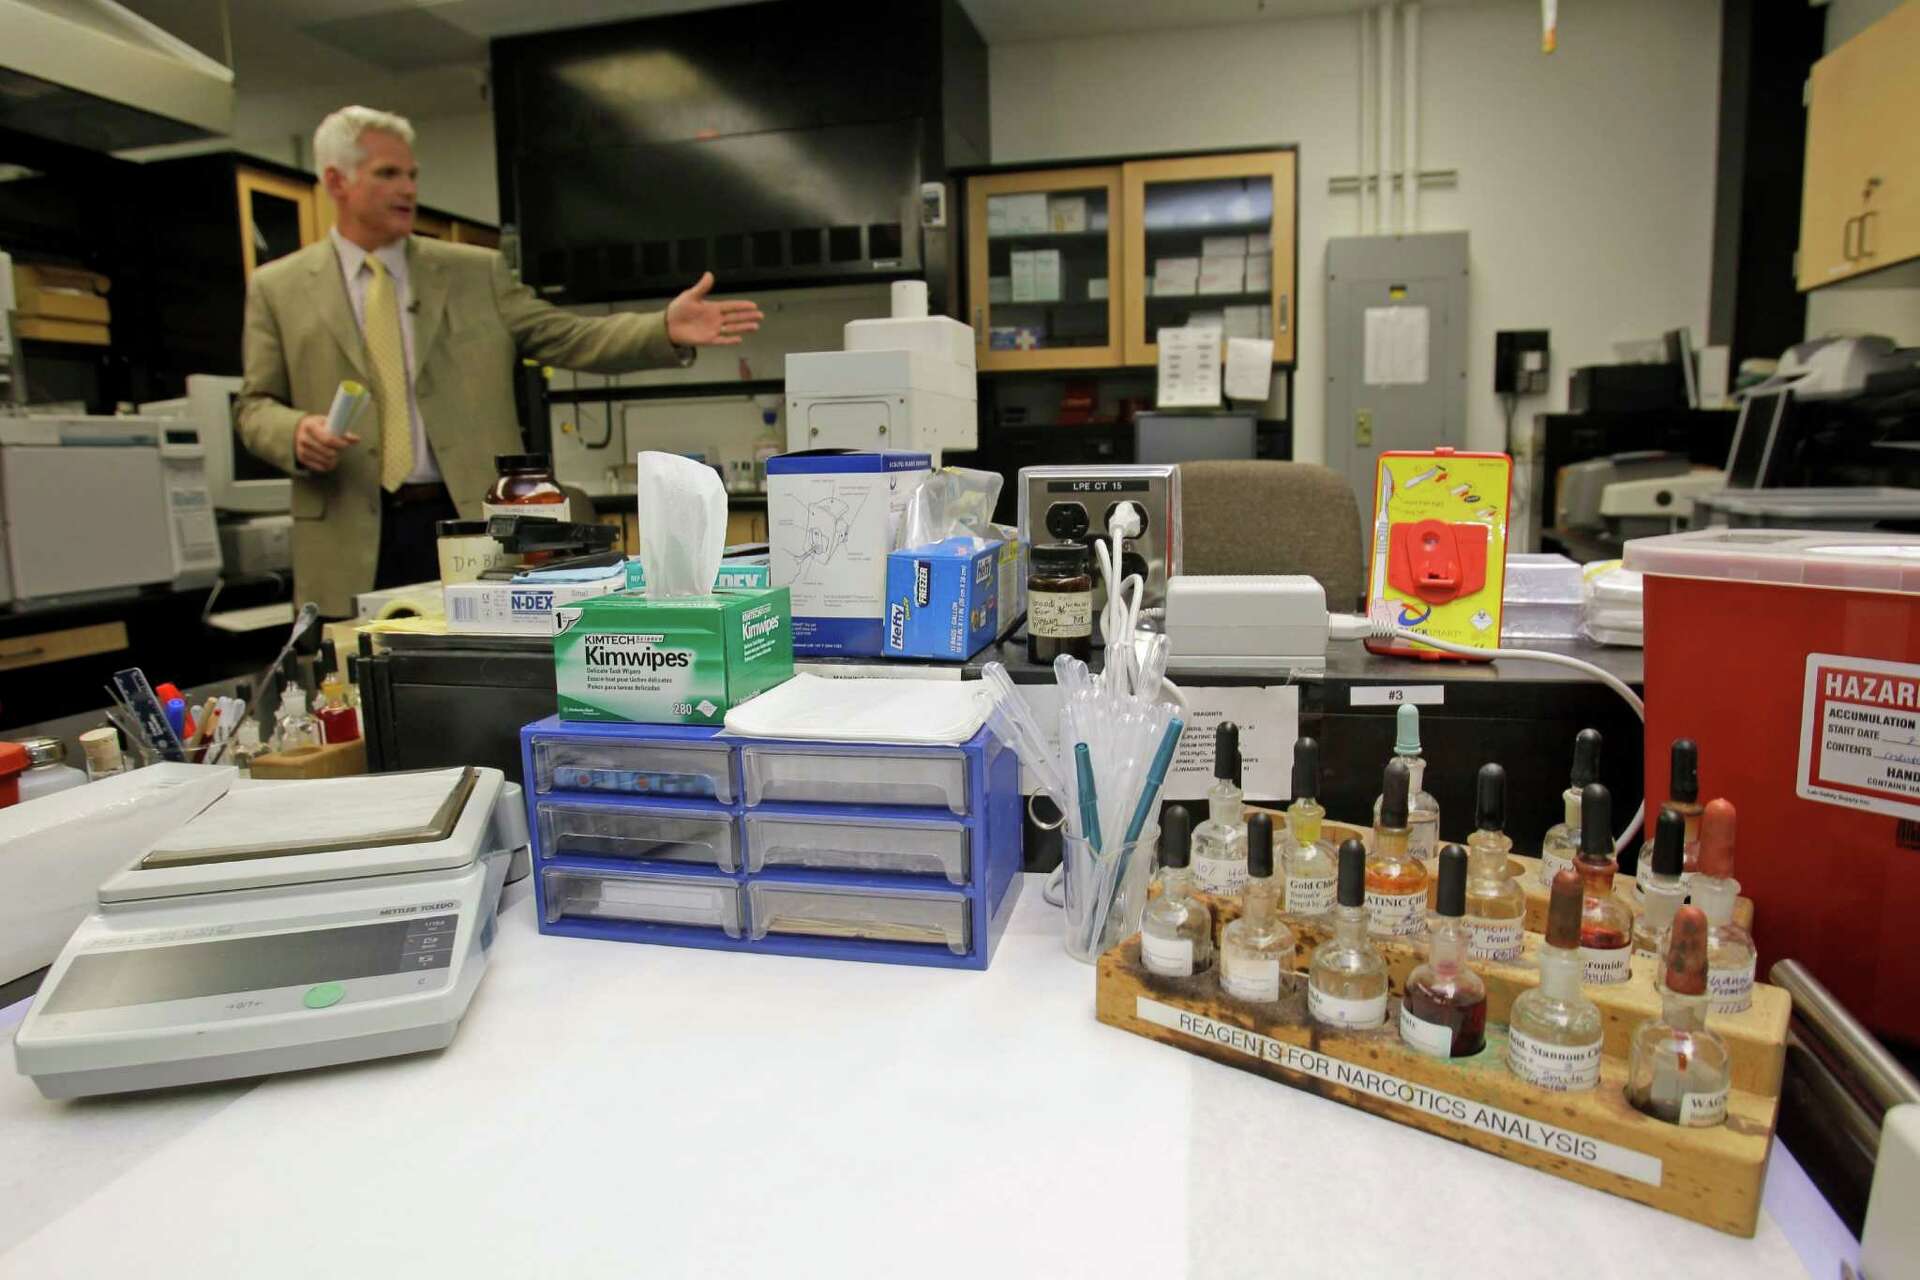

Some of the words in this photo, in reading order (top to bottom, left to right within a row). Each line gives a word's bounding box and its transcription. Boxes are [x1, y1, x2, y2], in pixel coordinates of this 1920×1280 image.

[1073, 482, 1089, 491] LPE
[1094, 482, 1107, 491] CT
[1112, 482, 1122, 490] 15
[919, 566, 929, 605] FREEZER
[511, 595, 553, 610] N-DEX
[742, 616, 779, 640] Kimwipes
[891, 605, 904, 649] Hefty
[585, 635, 636, 645] KIMTECH
[585, 645, 690, 671] Kimwipes
[1388, 690, 1403, 701] #3
[673, 703, 692, 715] 280
[1829, 708, 1916, 730] ACCUMULATION
[1828, 724, 1856, 737] START
[1857, 728, 1880, 740] DATE
[1826, 740, 1872, 757] CONTENTS
[1867, 777, 1907, 792] CONTAINS
[1290, 880, 1313, 890] Gold
[421, 902, 454, 912] TOLEDO
[1531, 1045, 1585, 1061] Stannous
[1180, 1013, 1282, 1060] REAGENTS
[1288, 1047, 1329, 1076] FOR
[1337, 1063, 1466, 1120] NARCOTICS
[1474, 1108, 1598, 1162] ANALYSIS
